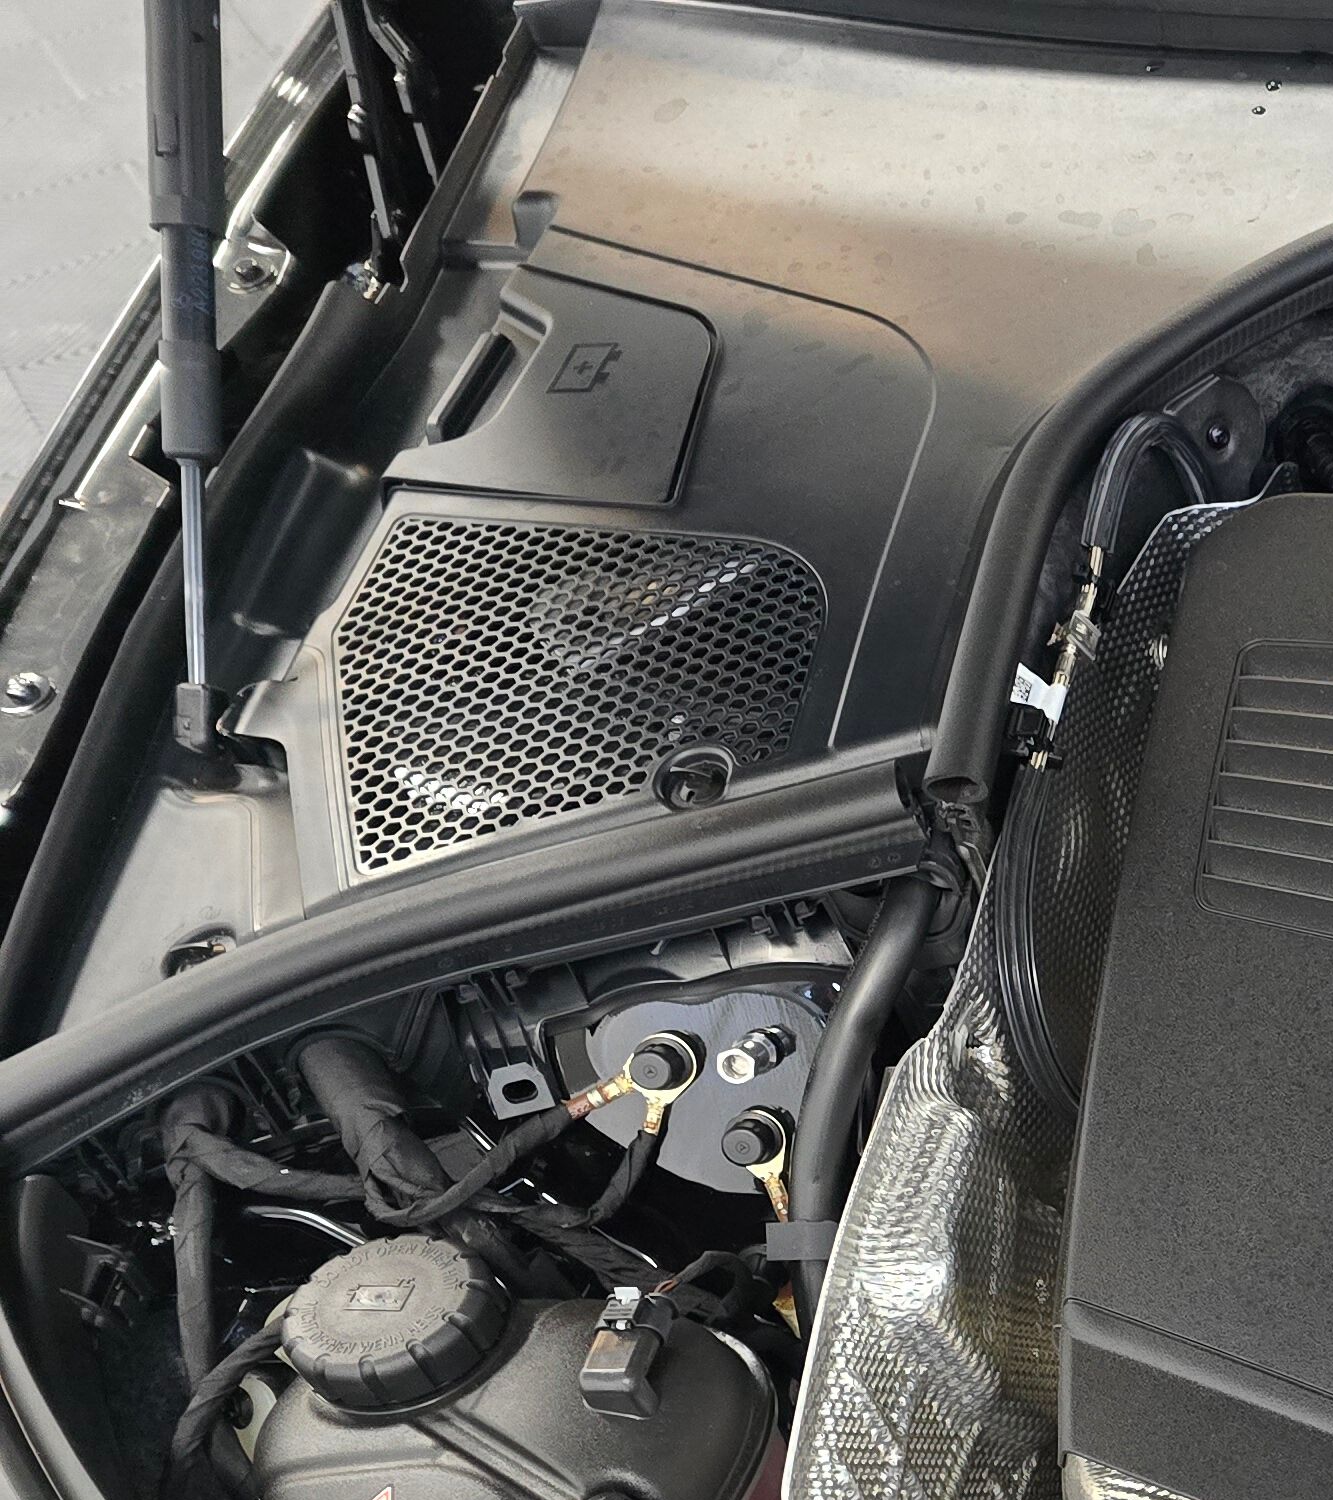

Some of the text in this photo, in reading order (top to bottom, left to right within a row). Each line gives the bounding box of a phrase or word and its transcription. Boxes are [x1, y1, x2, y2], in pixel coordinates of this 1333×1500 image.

[376, 1243, 418, 1258] OPEN
[420, 1244, 454, 1269] WHEN
[360, 1331, 406, 1354] WENN
